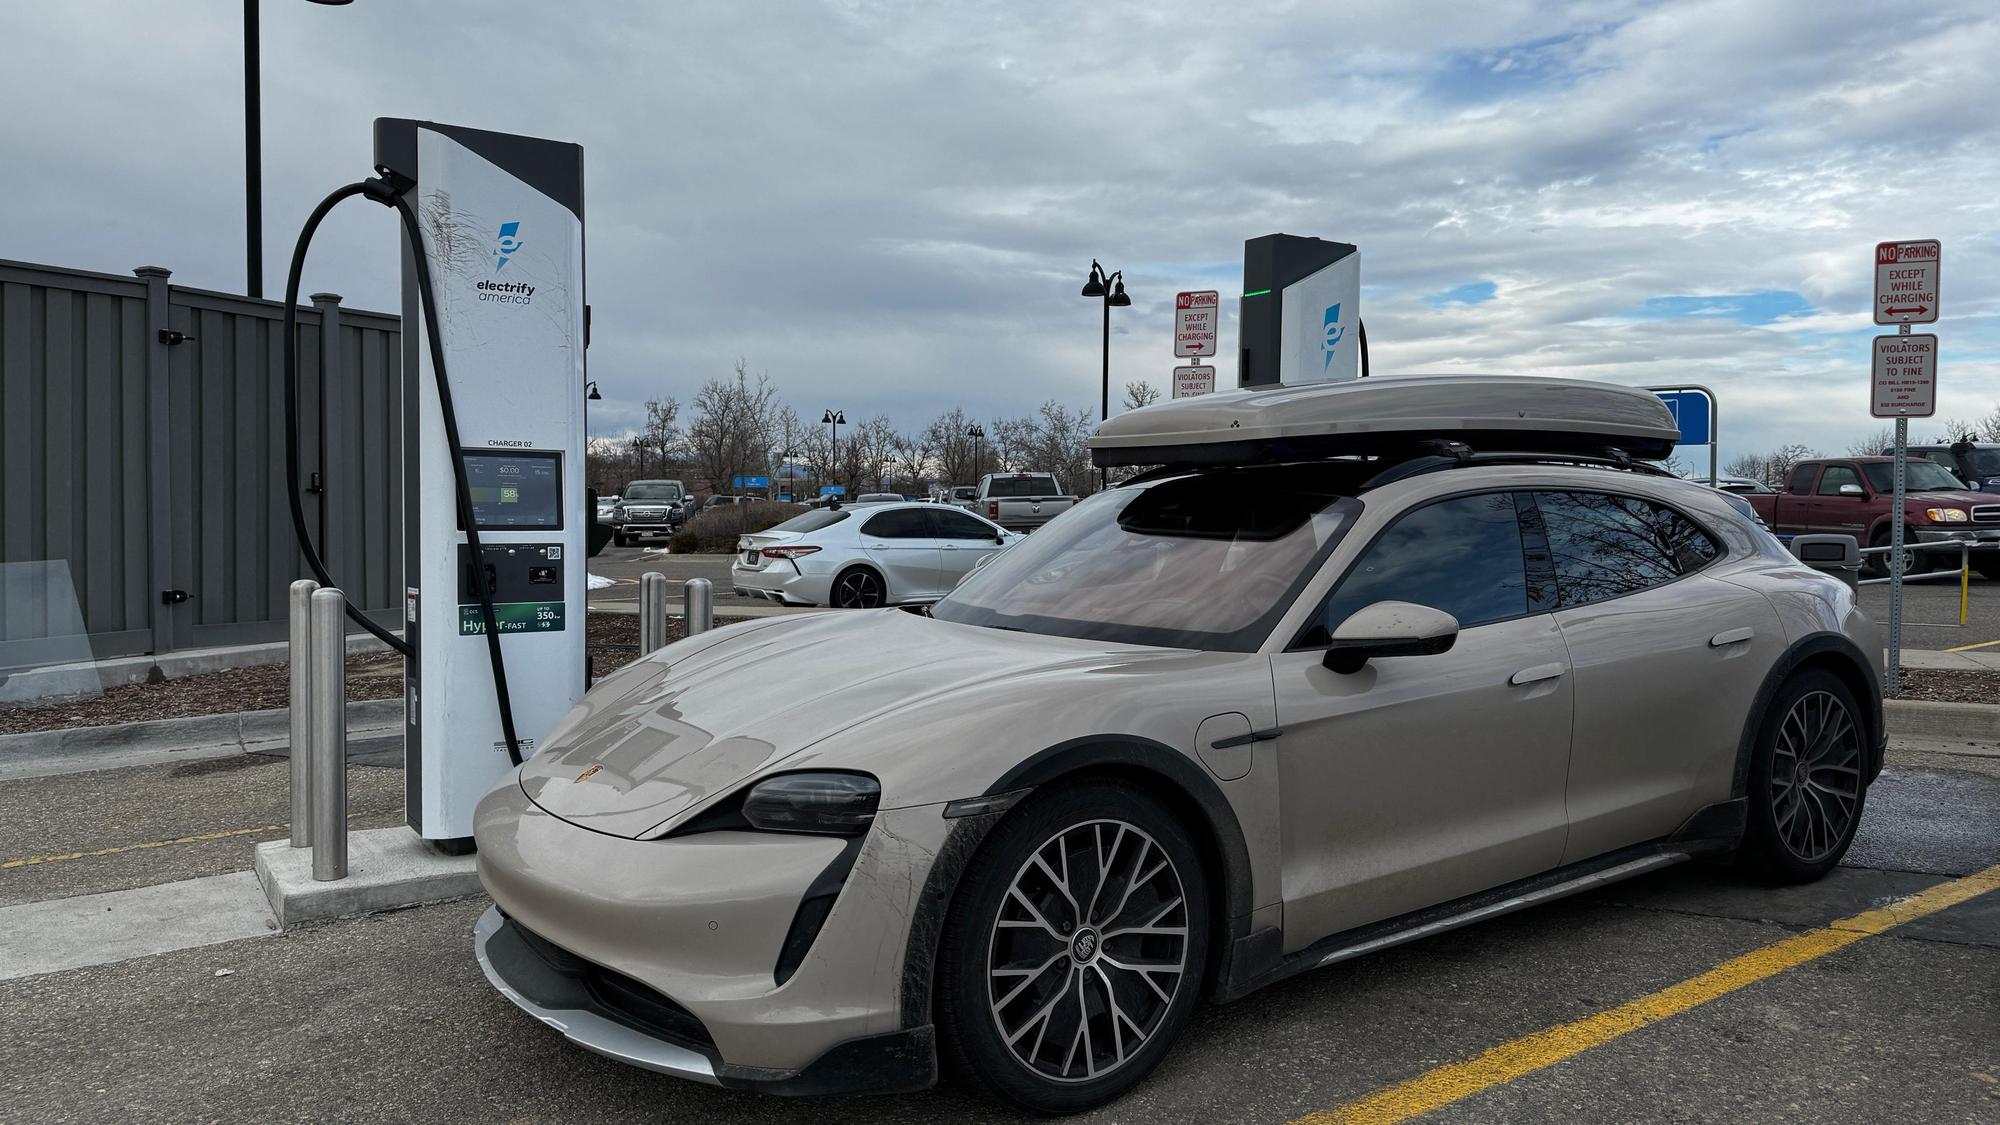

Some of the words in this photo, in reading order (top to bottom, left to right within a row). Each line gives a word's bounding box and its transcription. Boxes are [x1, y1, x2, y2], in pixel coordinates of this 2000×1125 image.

[1880, 247, 1895, 260] NO
[1898, 246, 1936, 259] PARKING
[1889, 269, 1926, 280] EXCEPT
[477, 280, 535, 296] electrify
[1891, 281, 1923, 291] WHILE
[478, 292, 531, 305] america
[1178, 295, 1190, 307] NO
[1190, 295, 1217, 305] PARKING
[1880, 293, 1933, 304] CHARGING
[1184, 313, 1209, 322] EXCEPT
[1185, 323, 1207, 331] WHILE
[1178, 332, 1214, 341] CHARGING
[1880, 344, 1930, 353] VIOLATORS
[1886, 356, 1924, 365] SUBJECT
[1886, 368, 1897, 376] TO
[1903, 368, 1923, 376] FINE
[1177, 373, 1211, 381] VIOLATORS
[488, 440, 523, 448] CHARGER
[537, 611, 554, 620] 350
[463, 620, 527, 634] Hypr-FAST
